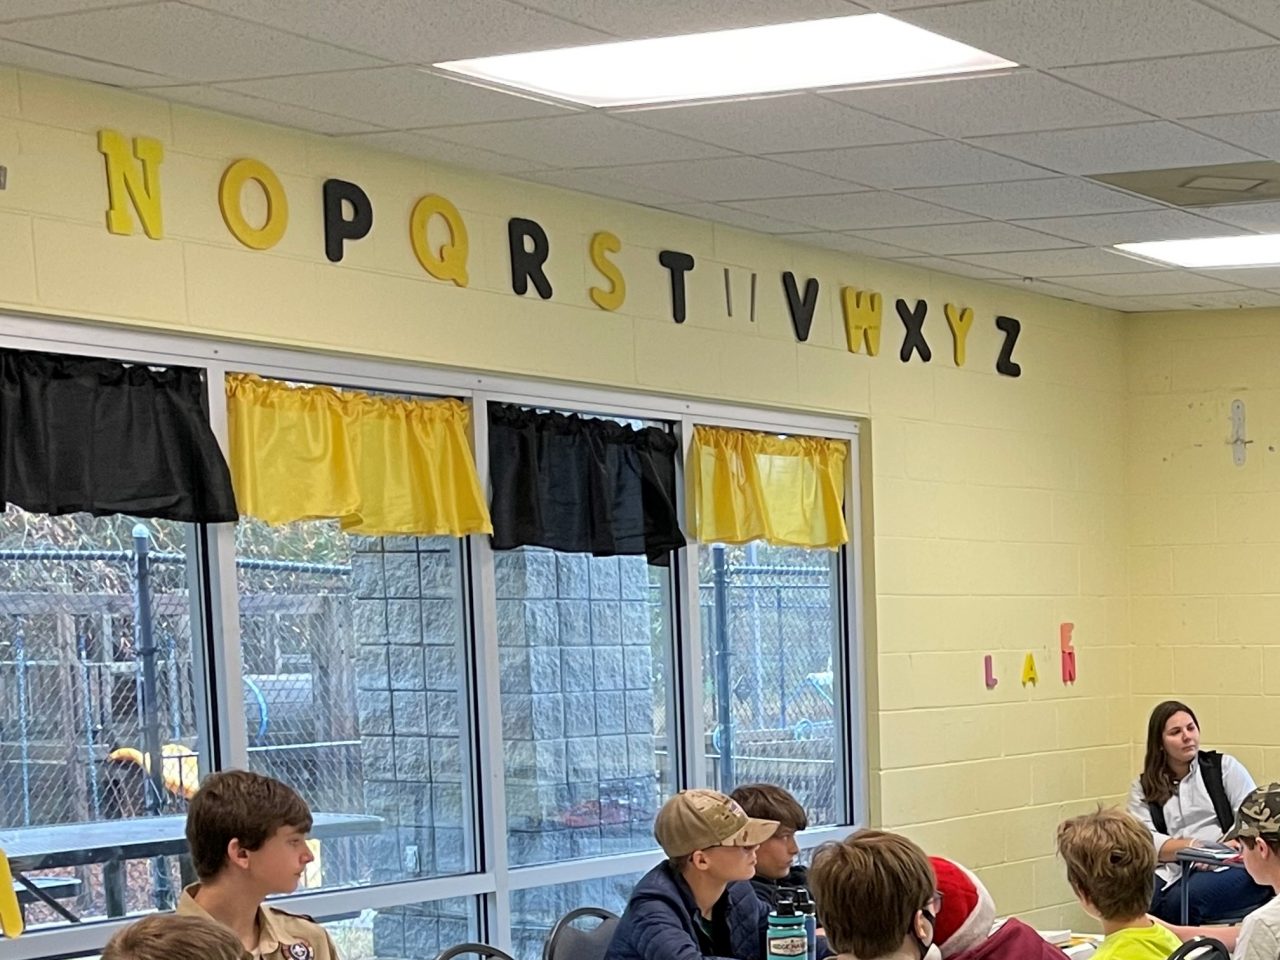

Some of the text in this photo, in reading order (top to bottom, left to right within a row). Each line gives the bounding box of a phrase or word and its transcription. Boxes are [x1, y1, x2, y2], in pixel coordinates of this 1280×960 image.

[97, 129, 163, 240] N
[219, 158, 288, 250] O
[323, 178, 373, 262] P
[410, 193, 469, 287] Q
[508, 217, 553, 299] R
[590, 231, 626, 311] S
[659, 250, 694, 324] T
[783, 271, 819, 342] V
[841, 285, 883, 357] W
[896, 299, 932, 363] X
[944, 303, 974, 367] Y
[996, 316, 1022, 378] Z
